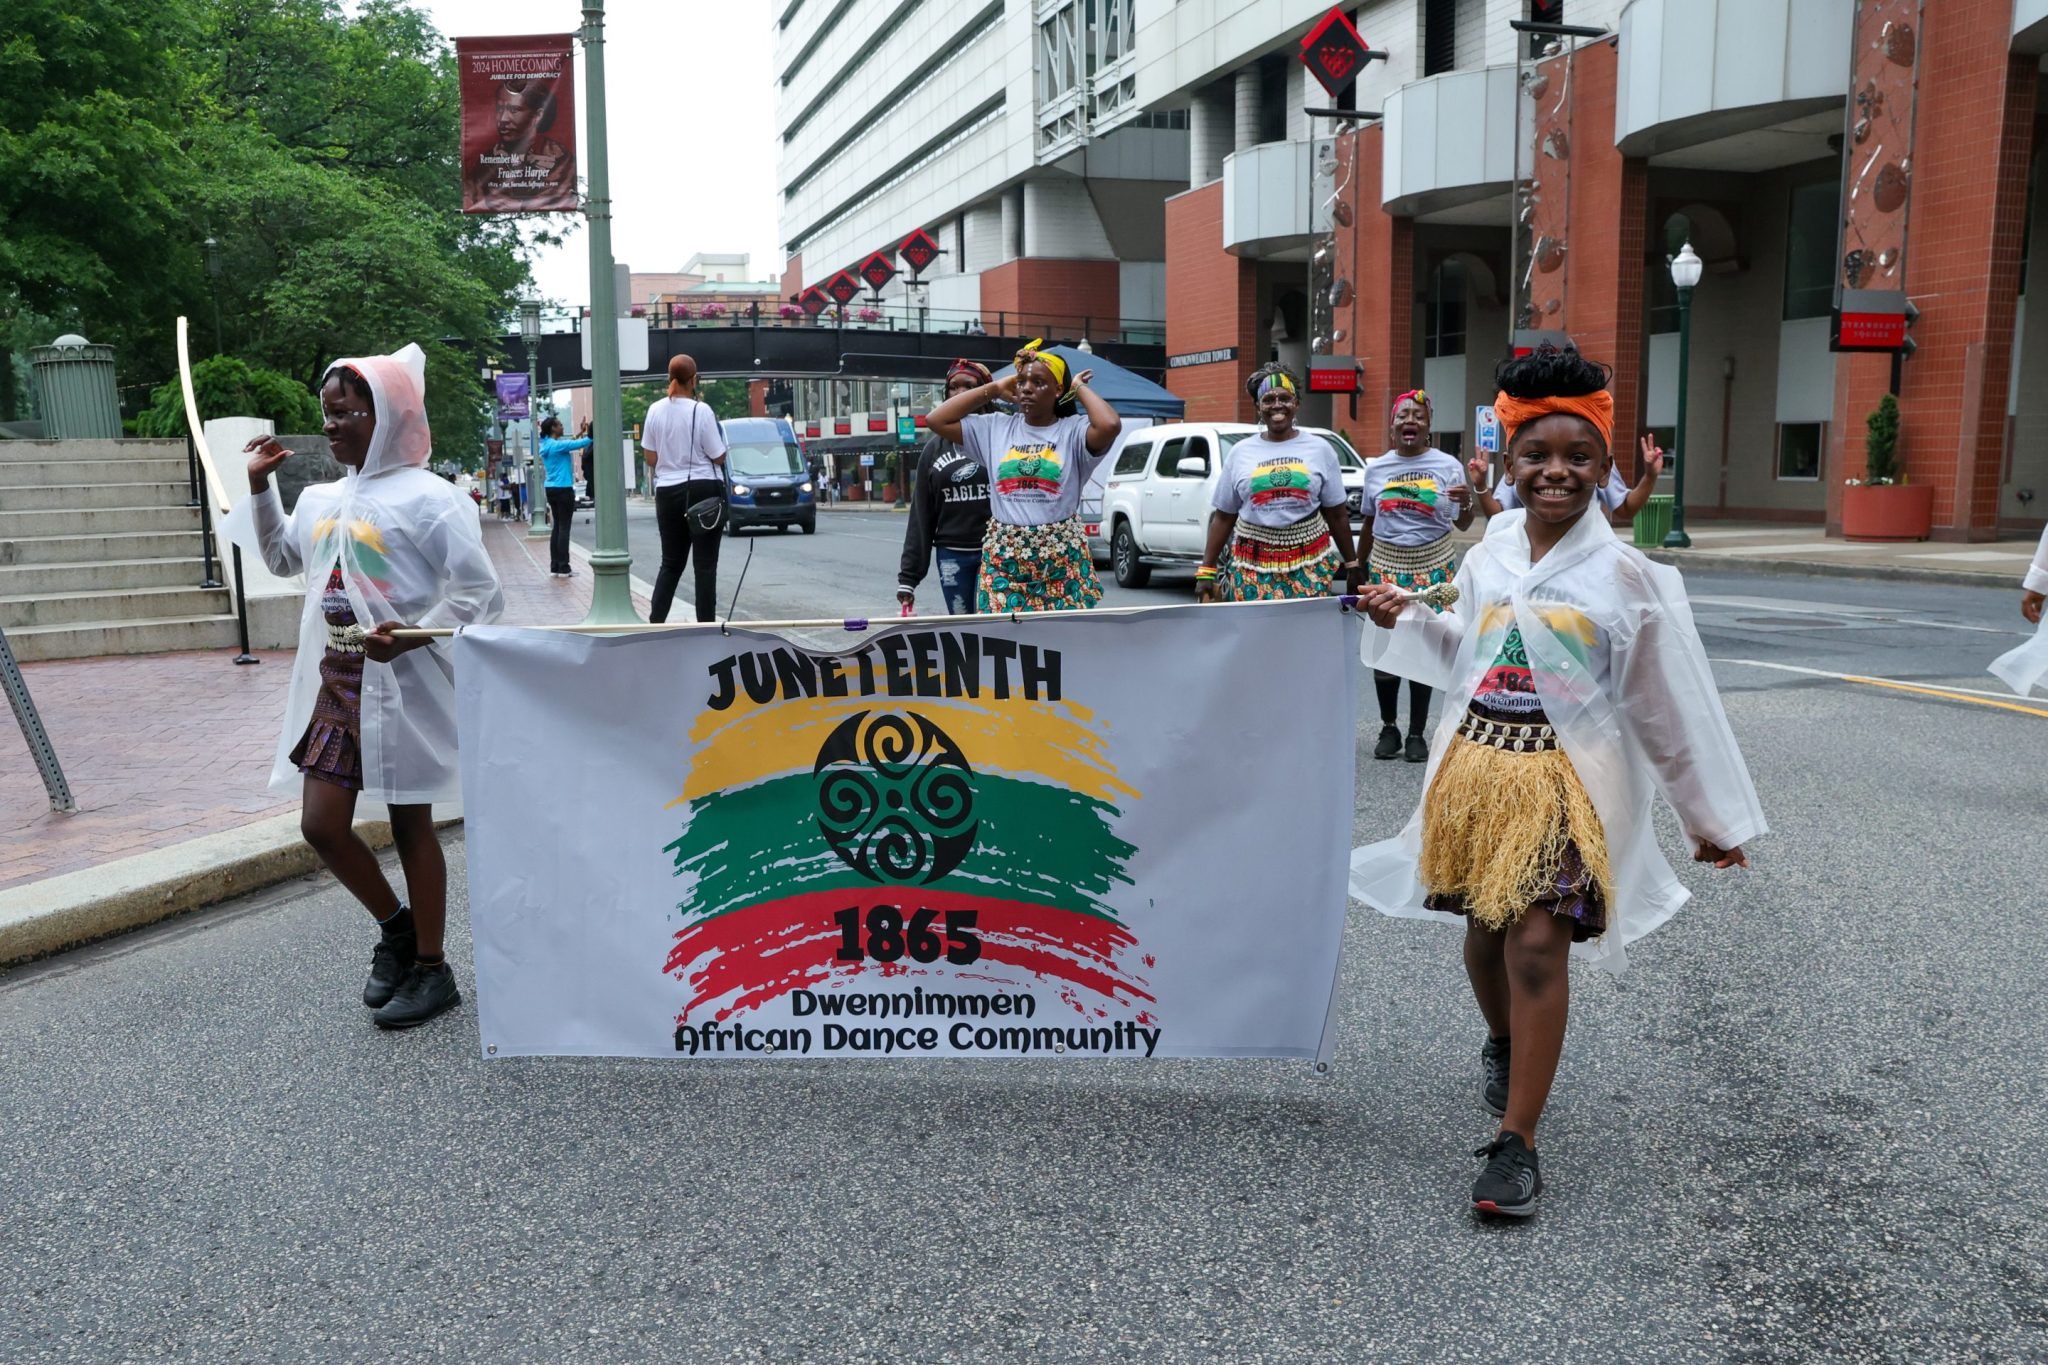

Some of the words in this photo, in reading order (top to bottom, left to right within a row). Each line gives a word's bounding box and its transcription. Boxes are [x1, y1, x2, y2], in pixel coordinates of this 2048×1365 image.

[472, 62, 490, 72] 2024
[491, 58, 562, 72] HOMECOMING
[480, 154, 510, 164] Remember
[498, 167, 524, 178] Frances
[524, 166, 550, 180] Harper
[1212, 348, 1232, 363] TOWER
[1010, 440, 1057, 454] JUNETEETH
[941, 482, 991, 502] EAGLES
[1017, 480, 1038, 490] 1865
[706, 631, 1062, 711] JUNETEENTH
[1496, 671, 1536, 693] 186
[832, 904, 982, 965] 1865
[791, 985, 1036, 1018] Dwennimmen
[674, 1022, 812, 1055] African
[823, 1024, 938, 1051] Dance
[948, 1021, 1162, 1058] Community
